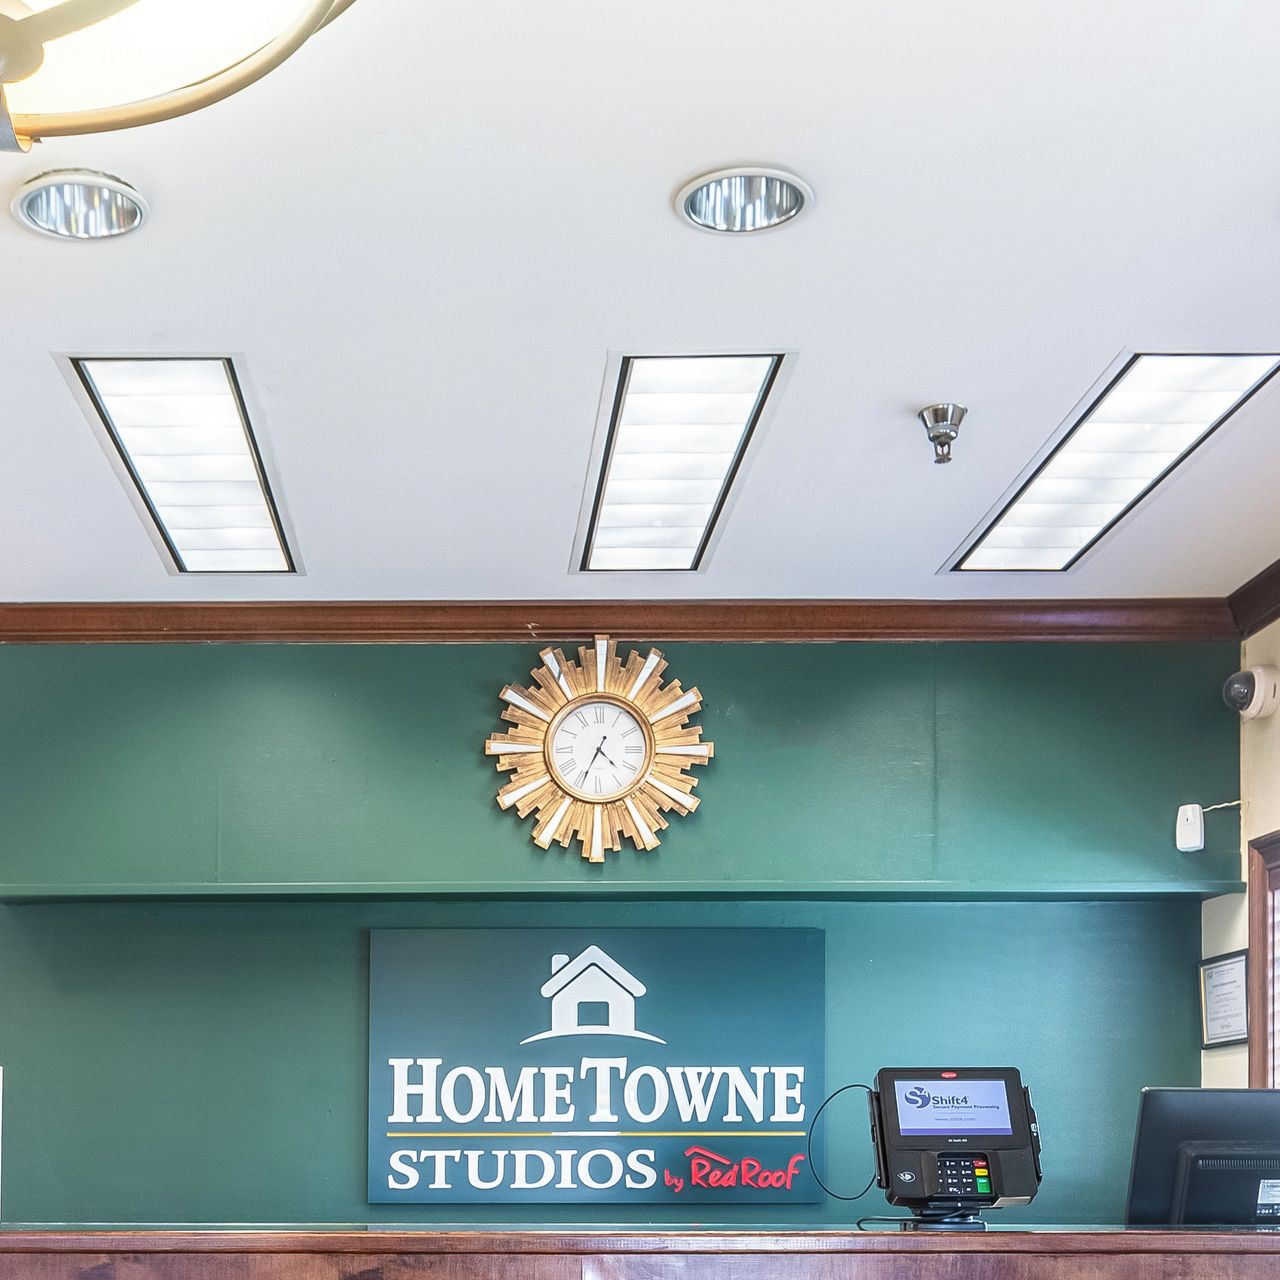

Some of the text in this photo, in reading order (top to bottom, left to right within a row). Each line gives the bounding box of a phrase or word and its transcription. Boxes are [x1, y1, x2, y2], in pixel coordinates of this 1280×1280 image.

[932, 1096, 968, 1105] Shift4
[387, 1148, 656, 1190] STUDIOS
[664, 1170, 684, 1192] by
